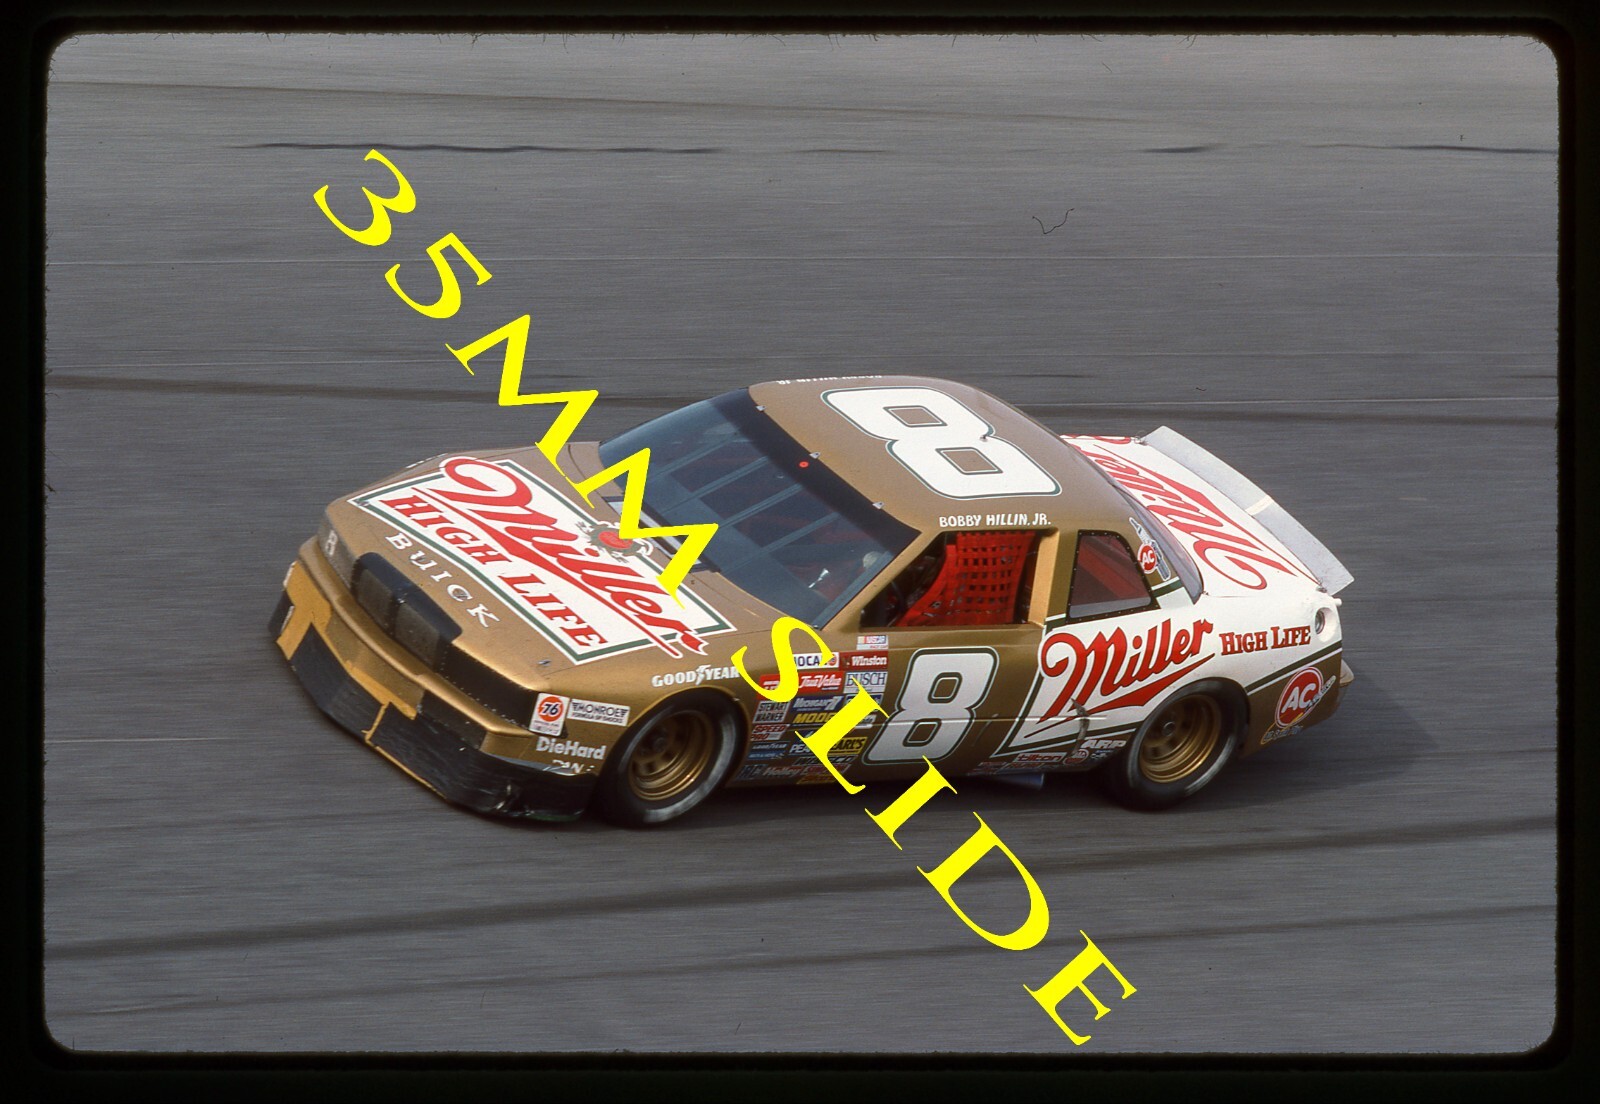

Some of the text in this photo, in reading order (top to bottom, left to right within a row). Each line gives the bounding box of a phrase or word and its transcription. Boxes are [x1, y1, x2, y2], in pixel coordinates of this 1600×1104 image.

[821, 386, 1062, 500] 8
[939, 515, 982, 527] BOBBY
[1032, 513, 1051, 526] JR.
[426, 457, 708, 655] Miller
[379, 495, 608, 646] HIGH LIFE
[386, 533, 500, 627] BUICK
[1219, 625, 1311, 655] HIGH LIFE
[851, 655, 887, 666] Winston
[651, 665, 740, 687] GOODYEAR
[846, 673, 887, 686] BUSCH
[1040, 618, 1213, 726] Miller
[759, 701, 787, 712] STEWART
[862, 646, 999, 764] 8
[1280, 682, 1316, 713] AC
[541, 703, 559, 716] 76
[576, 703, 622, 717] MONROE
[756, 712, 784, 722] WARNER
[754, 724, 785, 733] SPEED
[536, 736, 607, 760] DieHard
[789, 744, 812, 753] PEA
[1080, 739, 1127, 749] ARP
